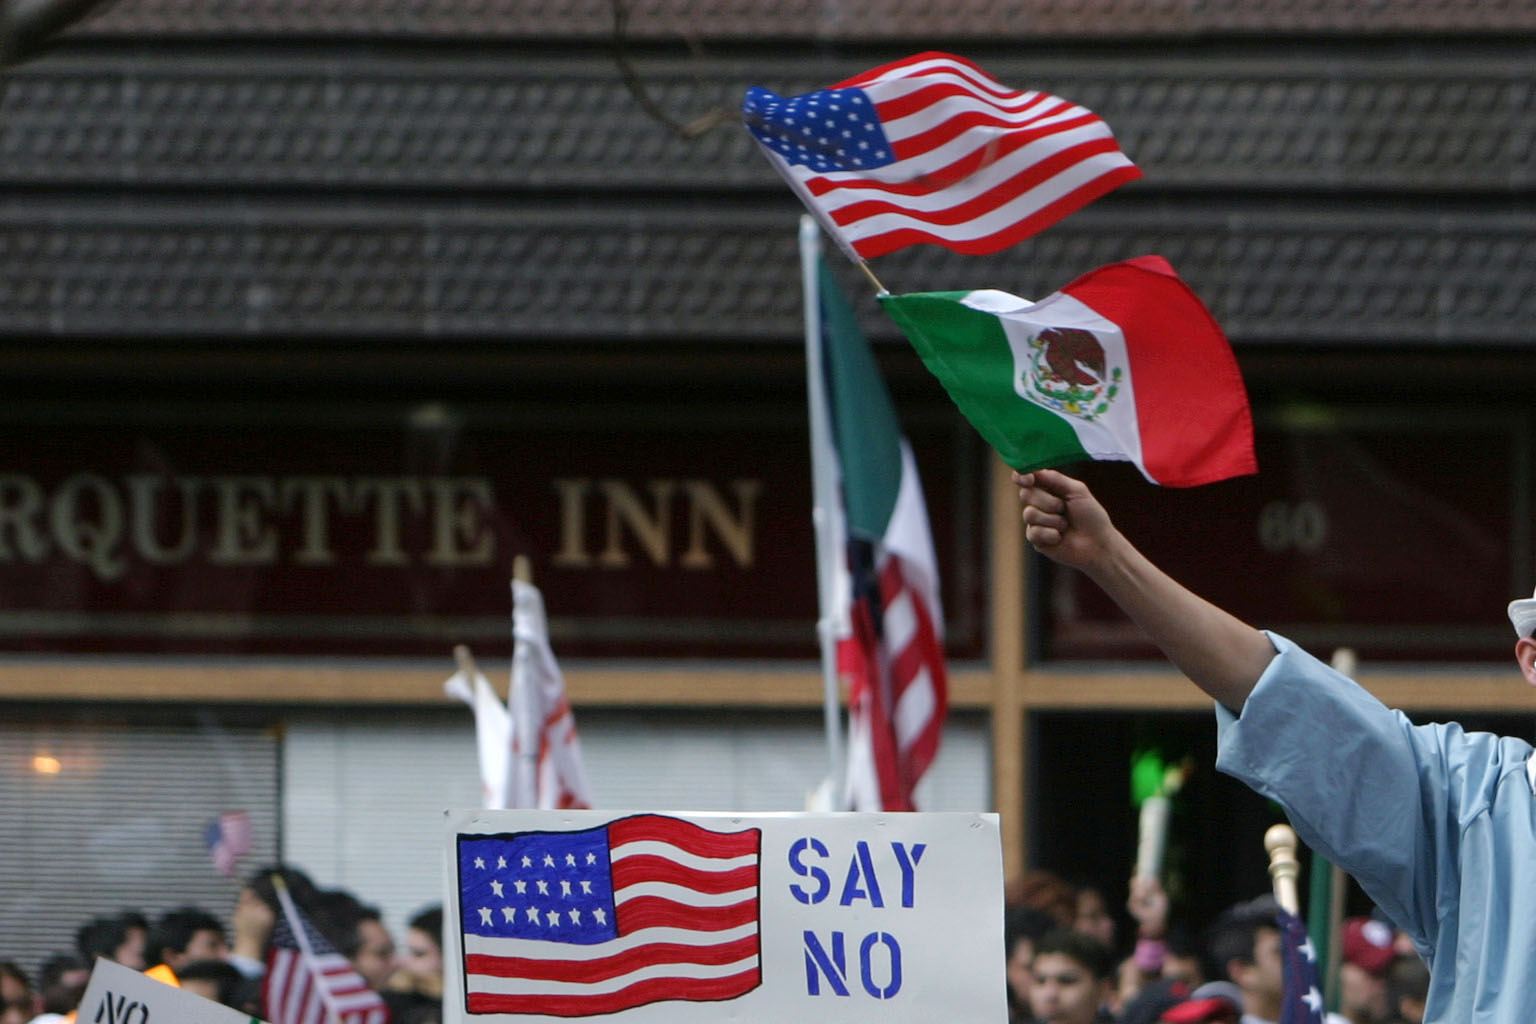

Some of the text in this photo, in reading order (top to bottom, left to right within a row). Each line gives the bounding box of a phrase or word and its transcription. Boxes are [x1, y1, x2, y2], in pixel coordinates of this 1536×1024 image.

[551, 477, 761, 569] INN
[788, 837, 927, 909] SAY
[803, 930, 903, 1000] NO
